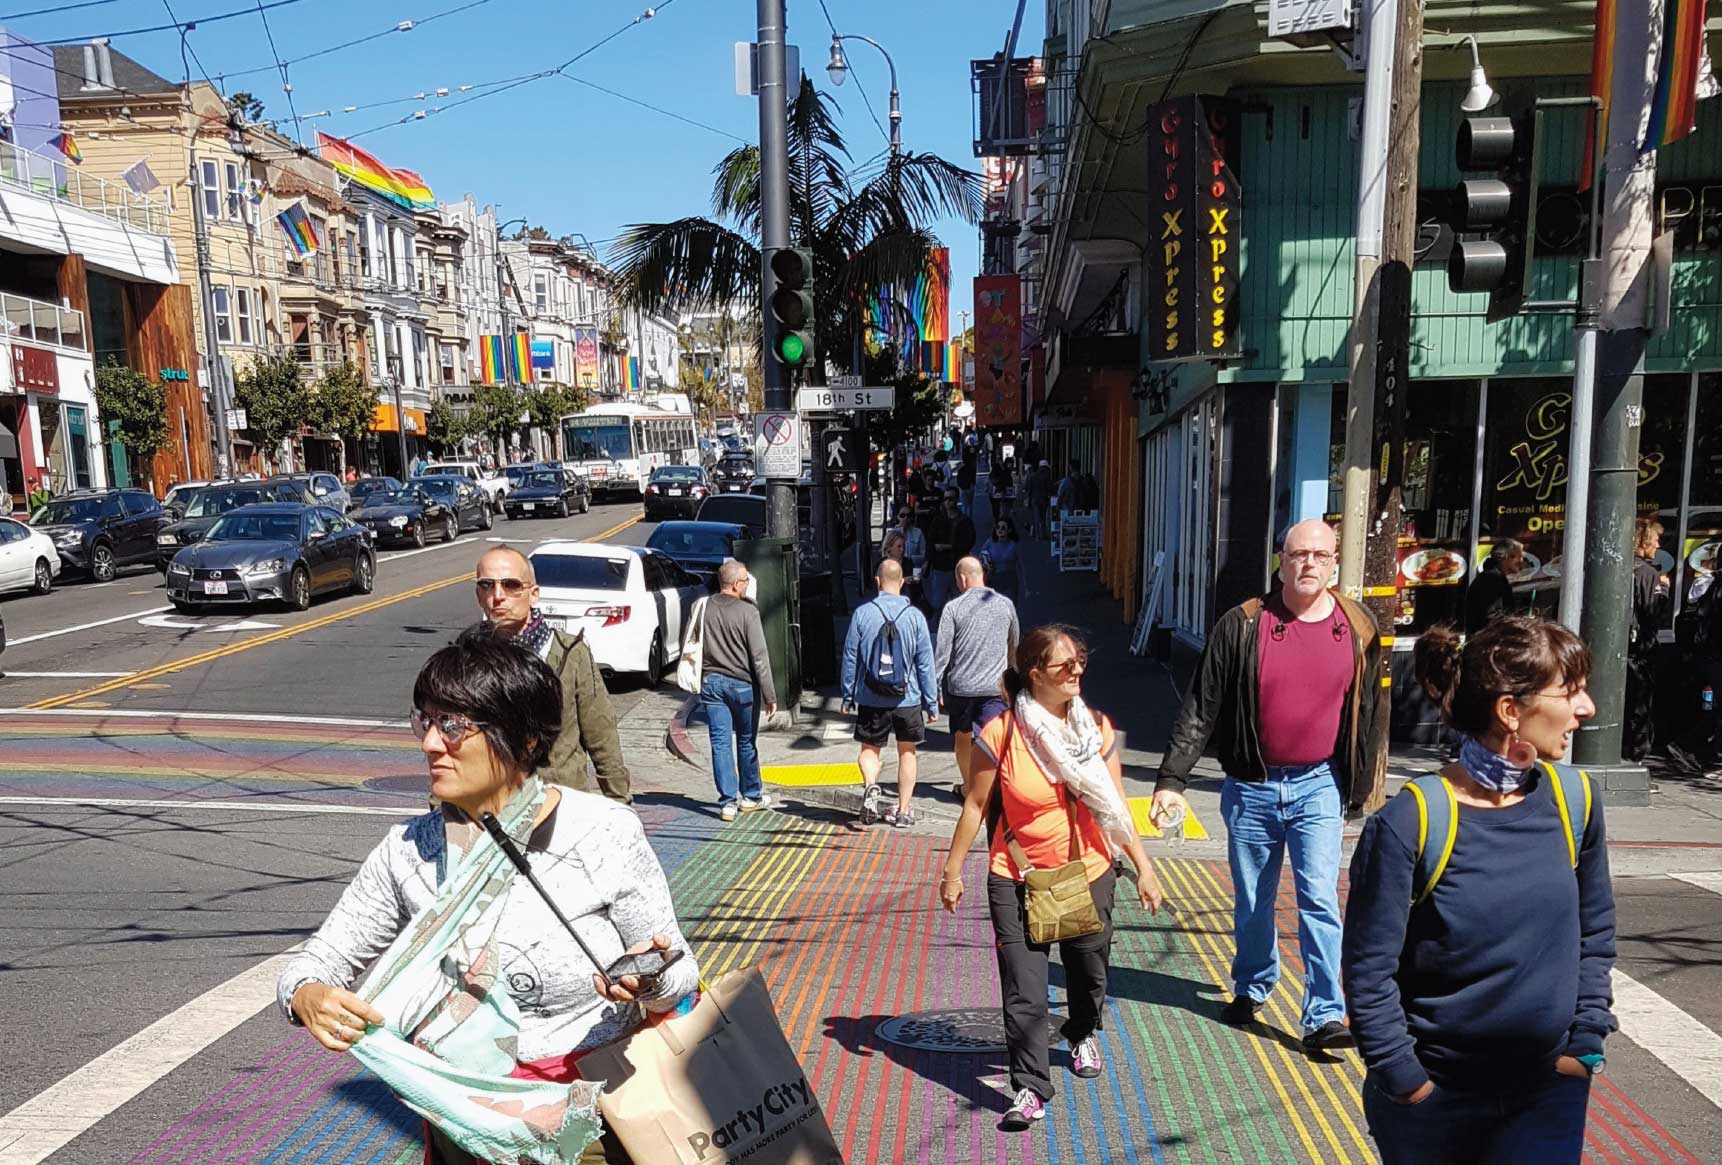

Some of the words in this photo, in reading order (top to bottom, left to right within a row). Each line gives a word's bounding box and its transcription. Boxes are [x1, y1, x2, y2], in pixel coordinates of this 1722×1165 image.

[1161, 208, 1183, 351] Xpress
[1208, 208, 1229, 348] Xpress
[160, 367, 190, 381] strut
[839, 377, 858, 386] 4100
[816, 393, 845, 406] 18th
[855, 392, 872, 405] St
[1497, 504, 1535, 514] Casual
[1527, 516, 1566, 534] Ope
[756, 1133, 776, 1152] MORE
[775, 1120, 797, 1139] PARTY
